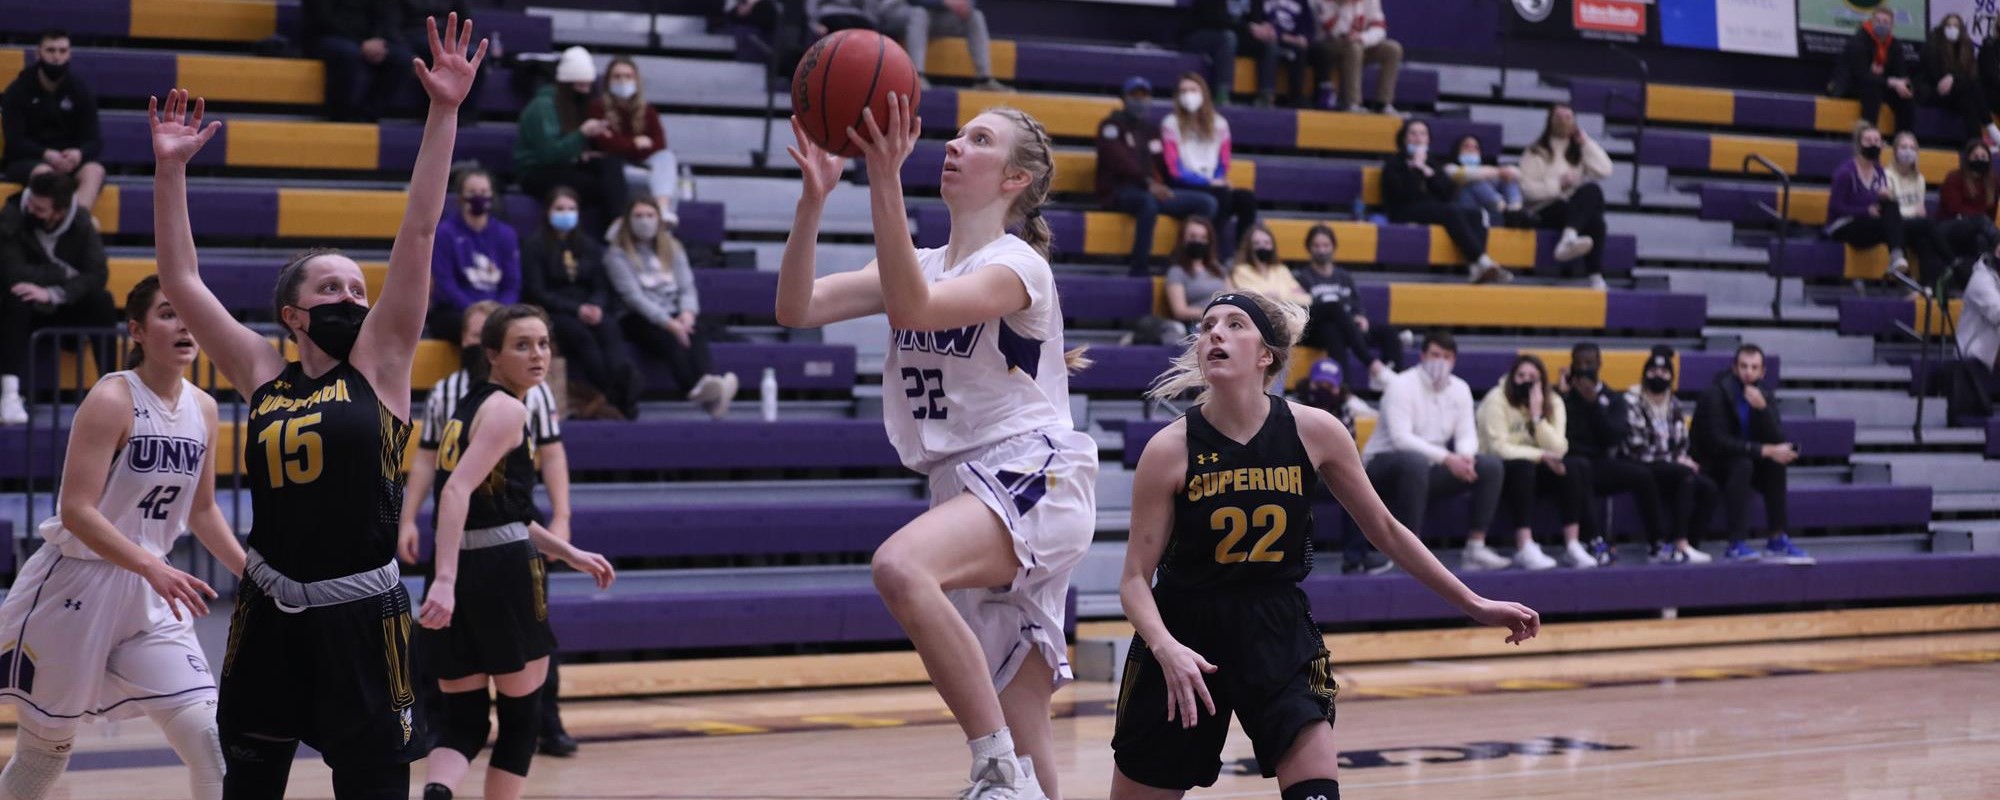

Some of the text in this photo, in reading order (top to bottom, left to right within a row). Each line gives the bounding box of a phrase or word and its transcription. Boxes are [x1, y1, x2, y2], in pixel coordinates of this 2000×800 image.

[893, 322, 985, 358] NW
[901, 367, 947, 420] 22
[128, 435, 208, 477] UNW
[258, 412, 324, 488] 15
[137, 485, 182, 520] 42
[1188, 465, 1303, 502] SUPERIOR
[1210, 504, 1288, 564] 22
